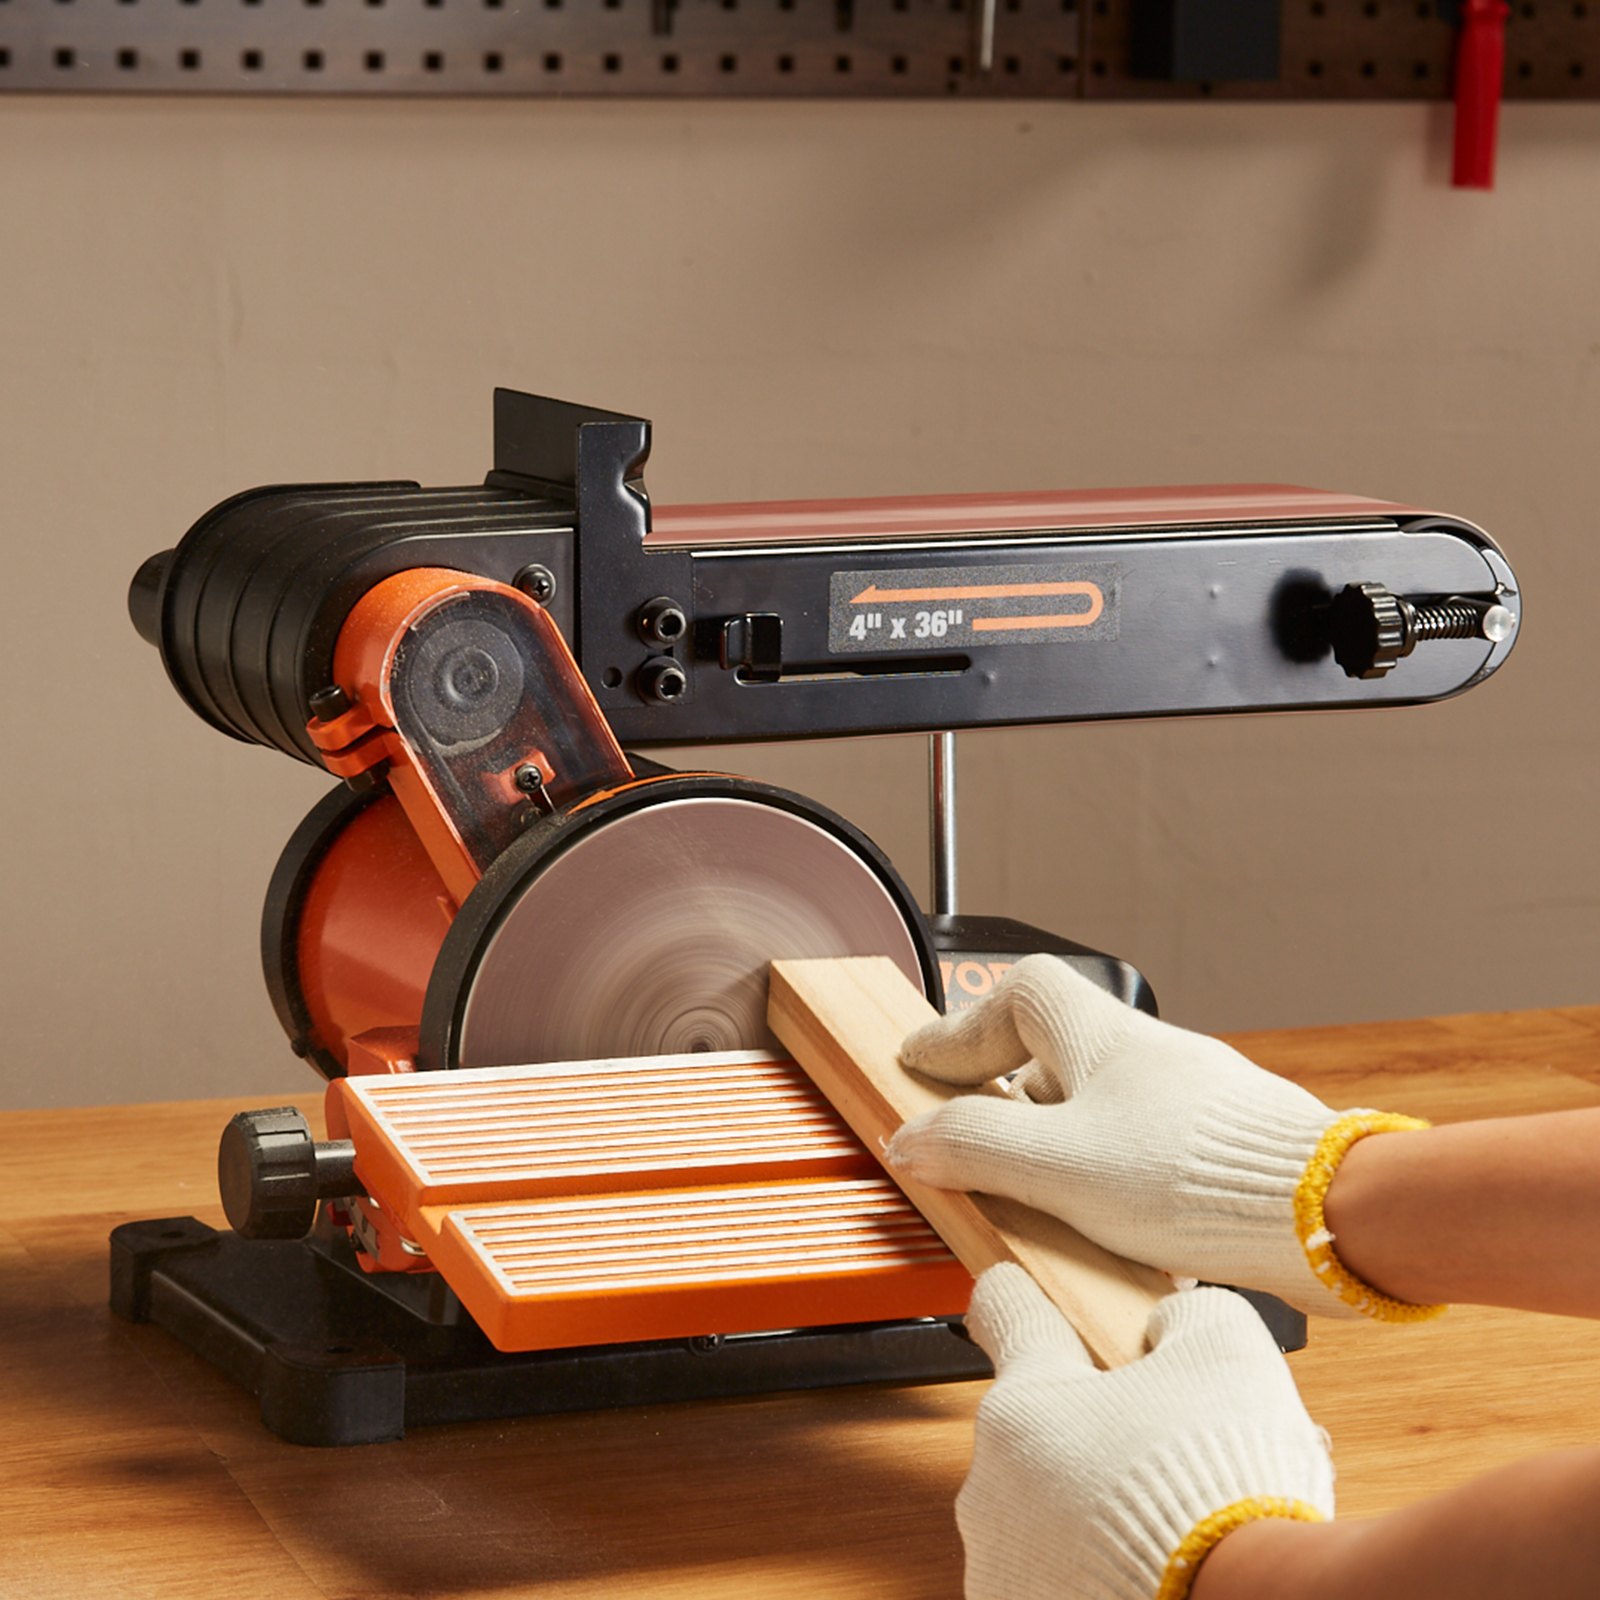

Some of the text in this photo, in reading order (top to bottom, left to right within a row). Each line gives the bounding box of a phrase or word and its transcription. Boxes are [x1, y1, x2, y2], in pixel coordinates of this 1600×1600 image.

[849, 609, 963, 640] 4" x 36"
